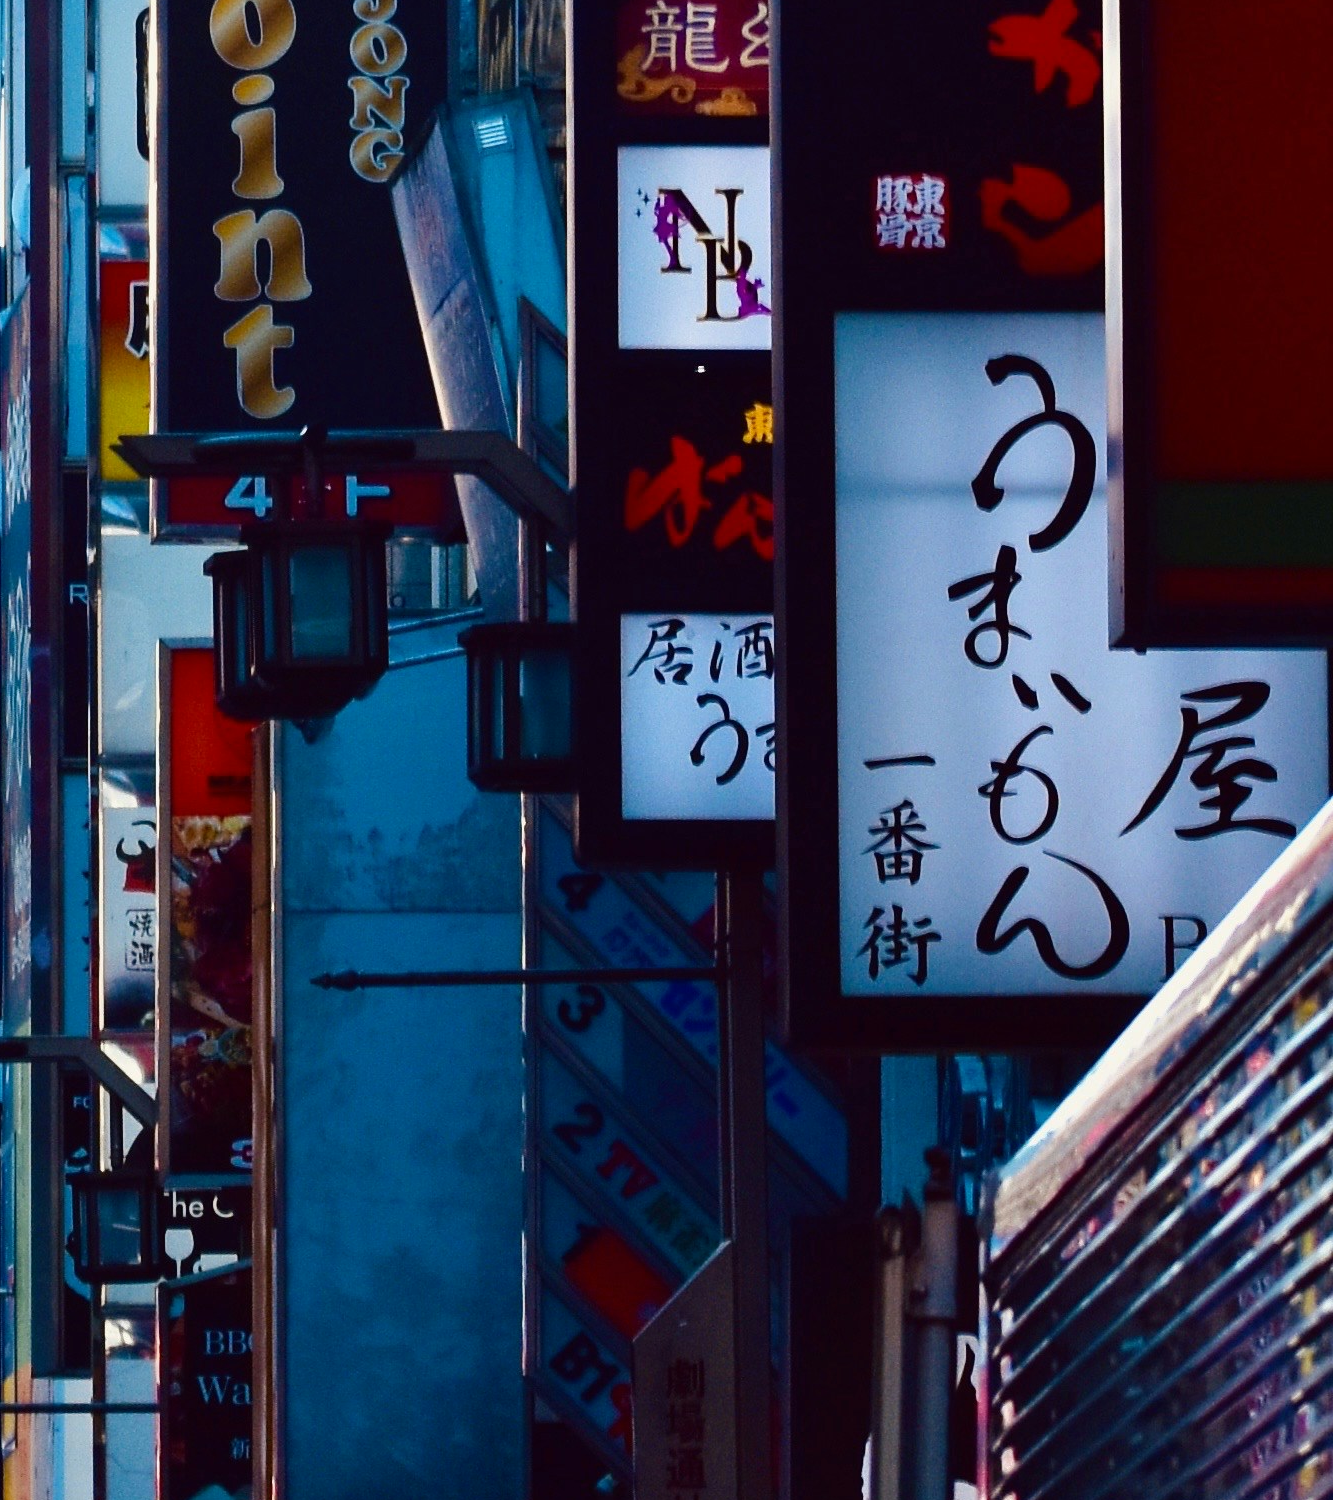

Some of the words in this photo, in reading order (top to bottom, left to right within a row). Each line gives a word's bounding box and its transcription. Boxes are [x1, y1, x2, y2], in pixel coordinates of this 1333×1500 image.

[1119, 680, 1298, 840] 屋
[862, 756, 942, 988] 一番街
